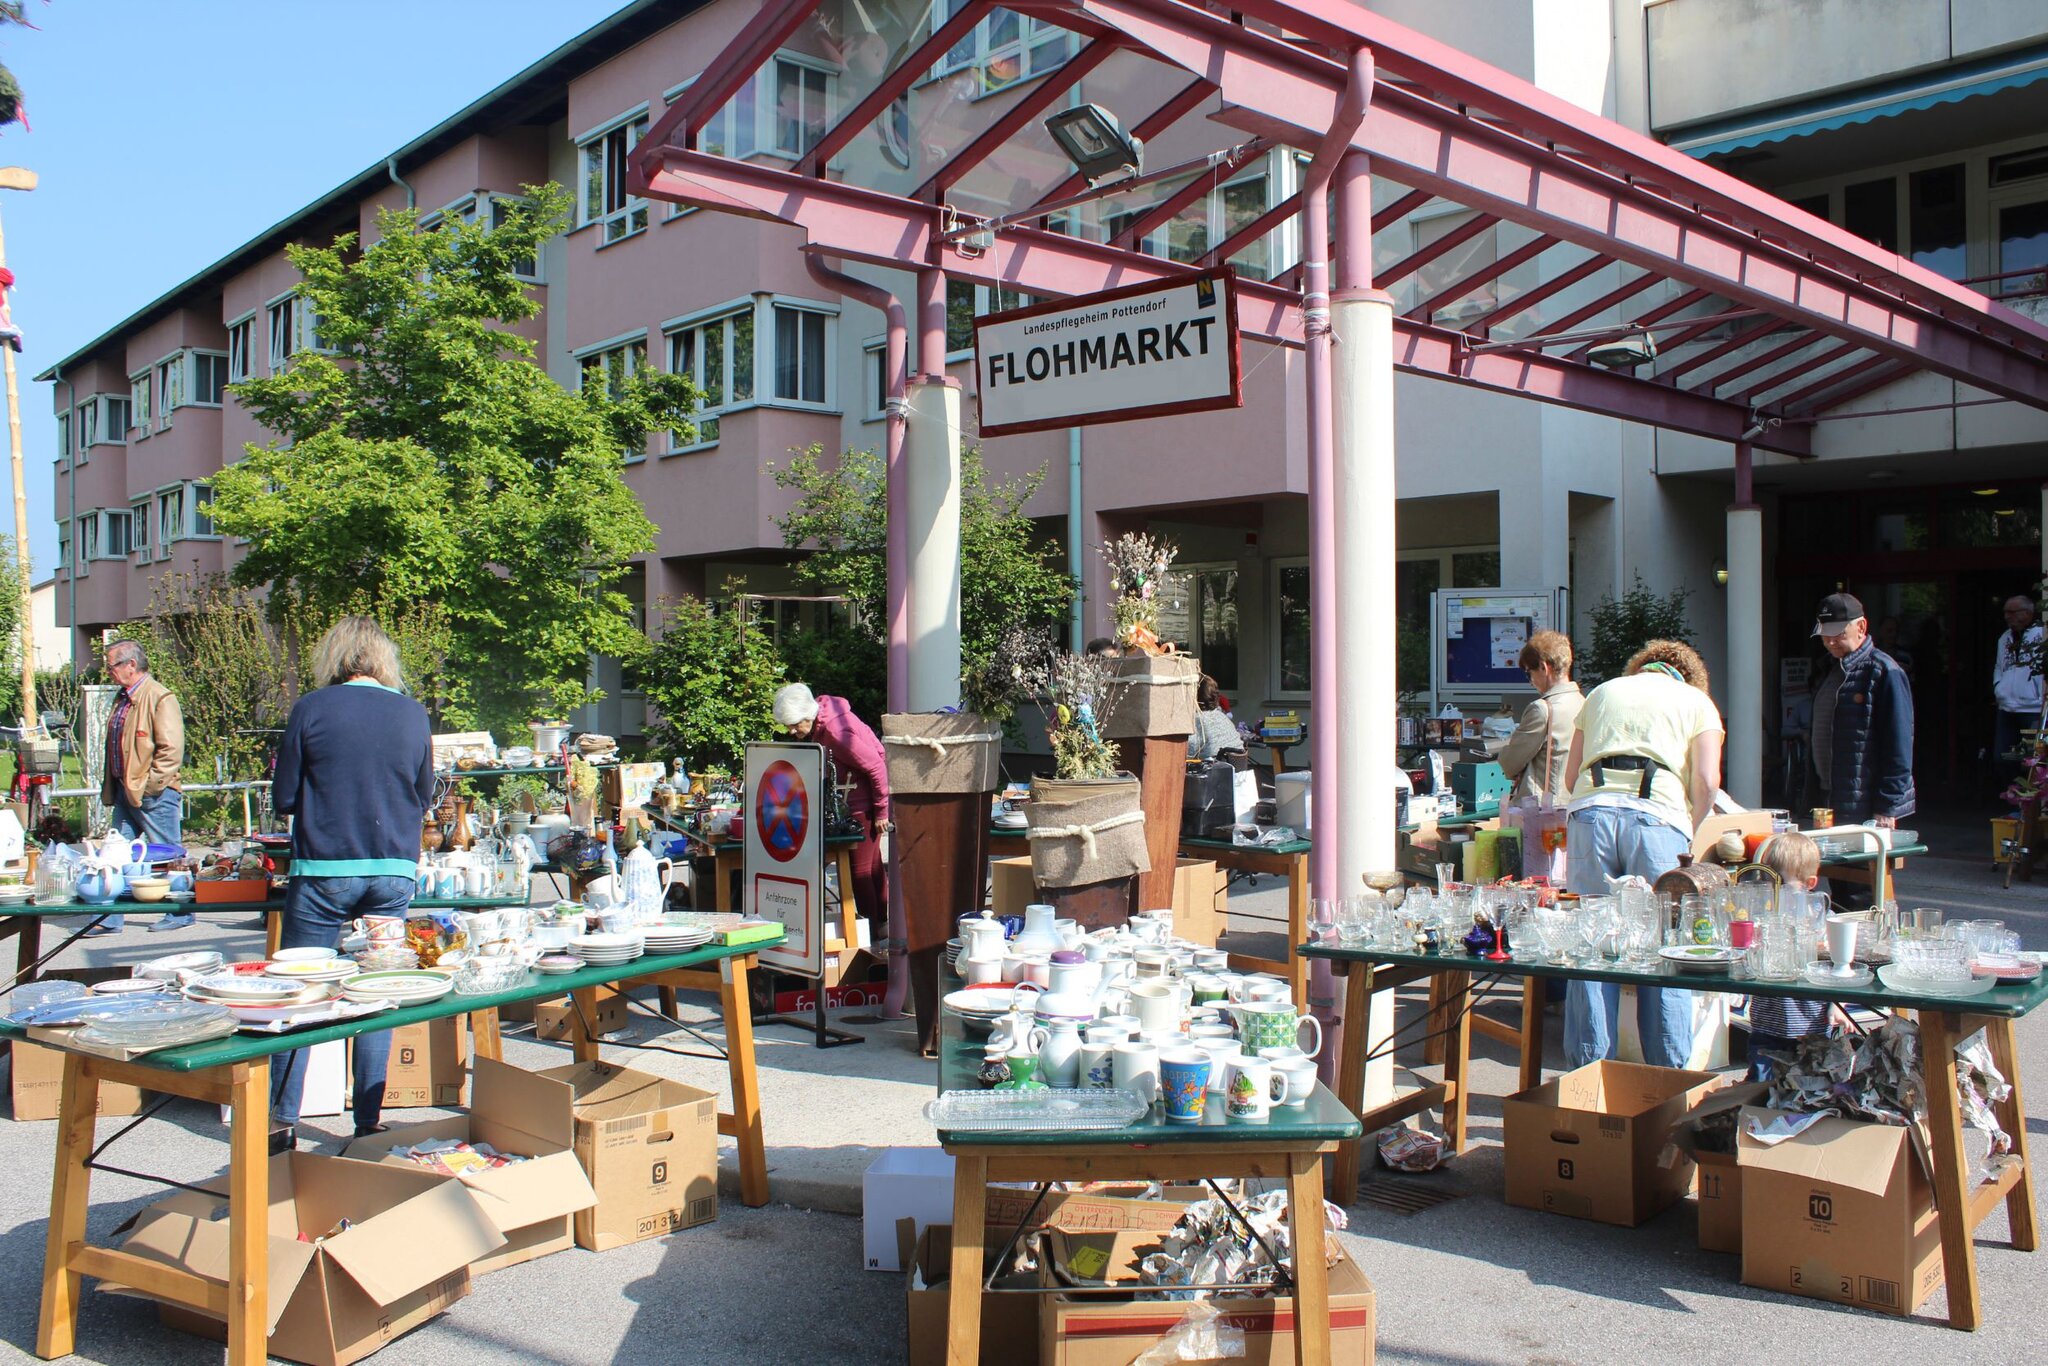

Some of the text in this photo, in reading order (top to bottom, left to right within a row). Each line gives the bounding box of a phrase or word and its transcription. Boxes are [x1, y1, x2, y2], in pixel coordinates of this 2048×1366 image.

[1024, 298, 1167, 335] Landespflegeheim Pottendorf
[988, 316, 1216, 388] FLOHMARKT
[1810, 1199, 1831, 1217] 10
[639, 1213, 680, 1233] 201 312
